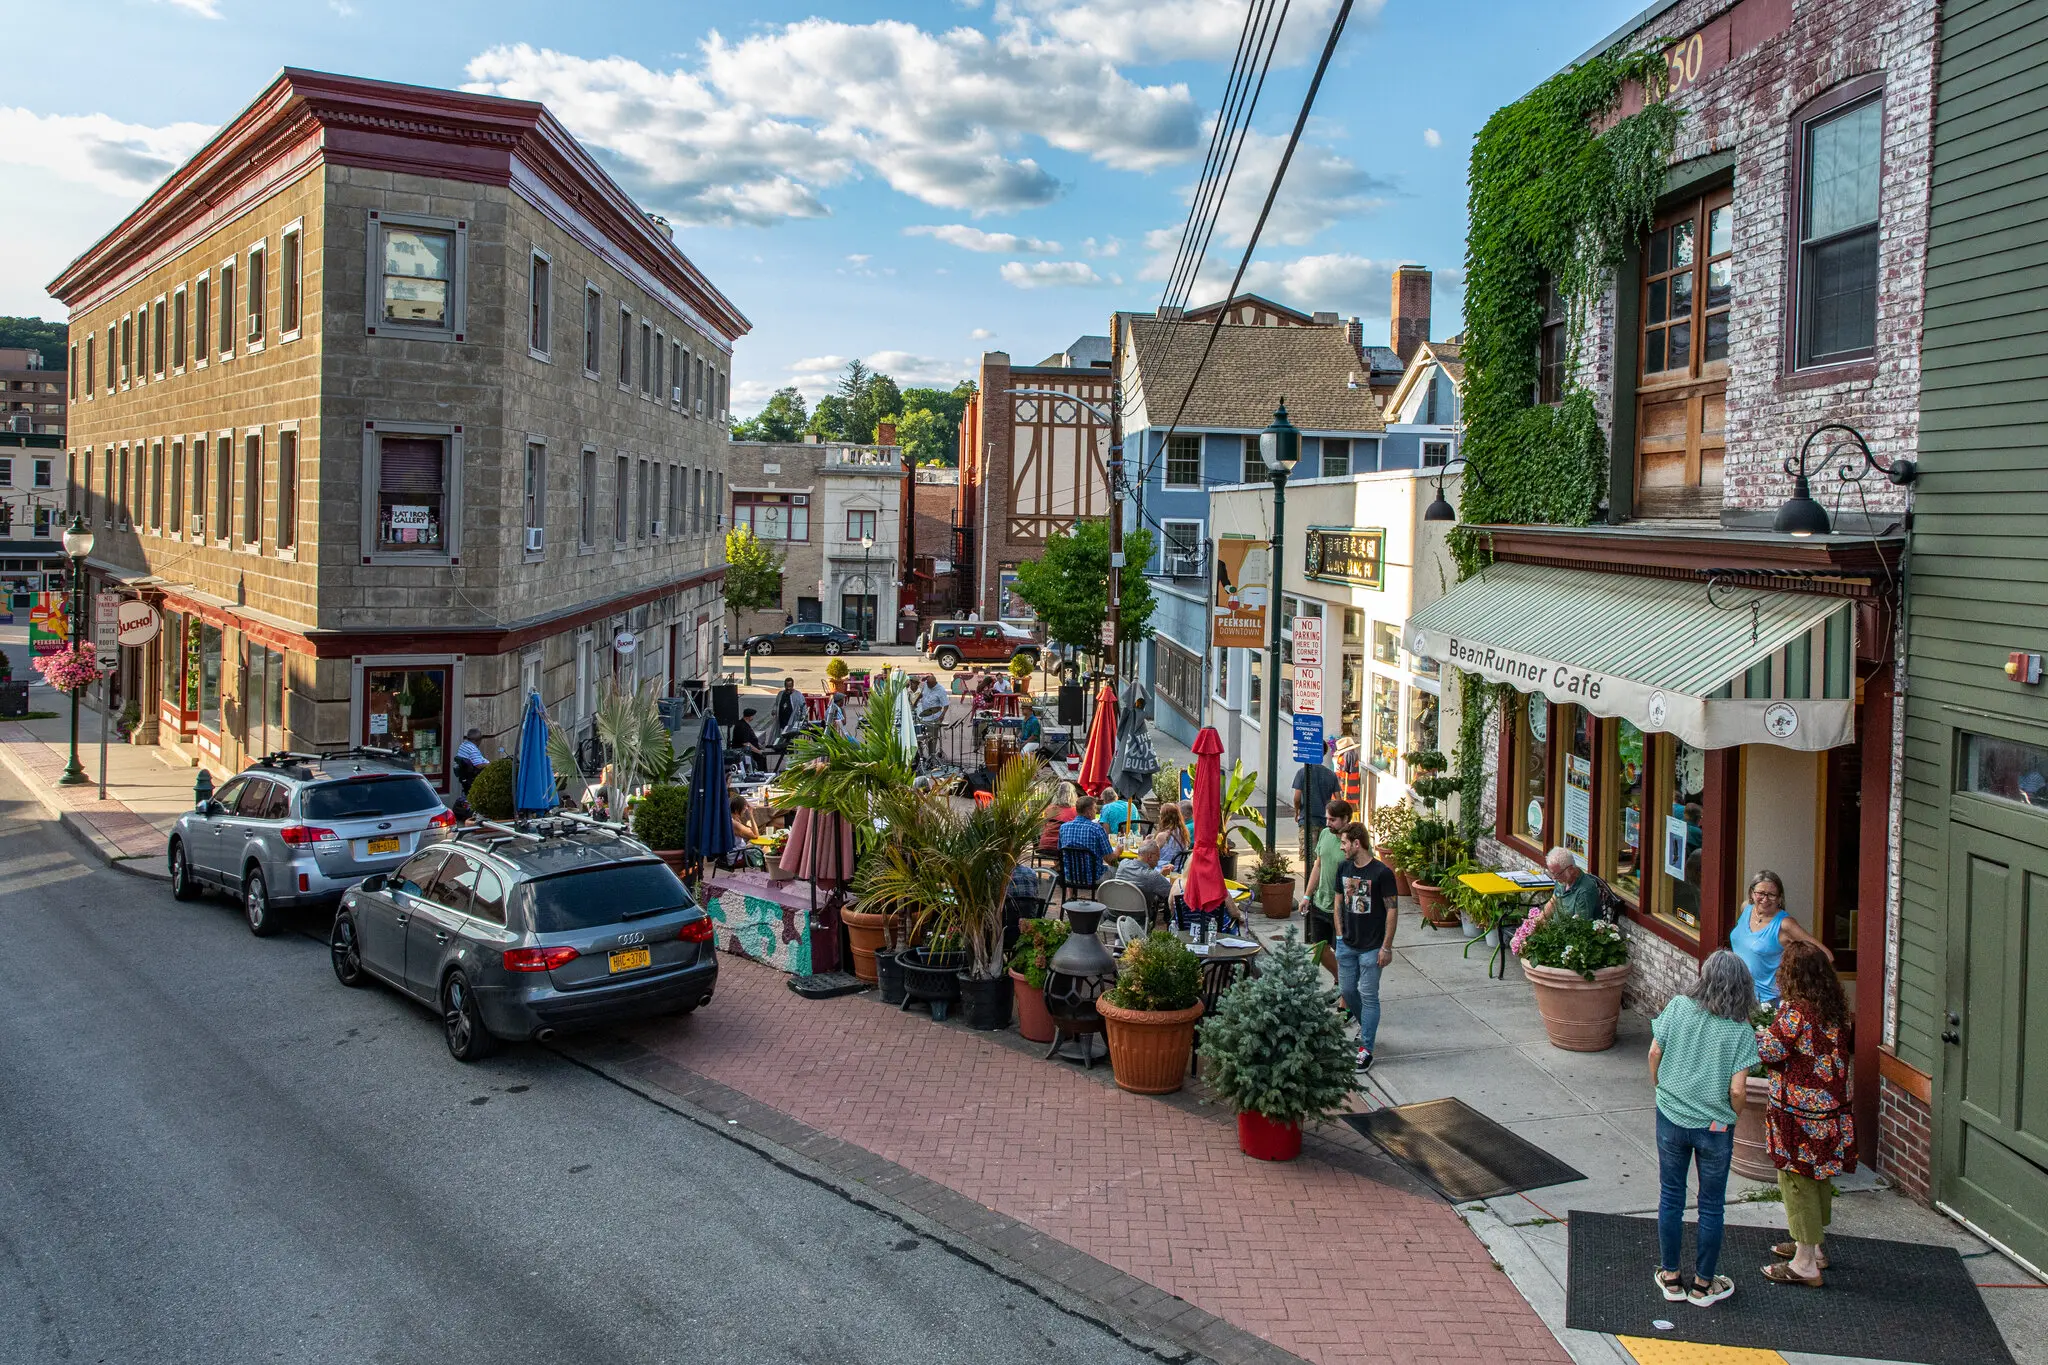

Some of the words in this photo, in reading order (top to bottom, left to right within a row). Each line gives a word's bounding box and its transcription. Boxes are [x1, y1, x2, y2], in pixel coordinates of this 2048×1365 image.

[1218, 618, 1262, 628] PEEKSKILL
[1301, 620, 1313, 630] NO
[1219, 627, 1260, 636] DOWNTOWN
[1295, 631, 1320, 641] PARKING
[1296, 648, 1319, 656] CORNER
[1301, 669, 1314, 679] NO
[1450, 638, 1548, 683] BeanRunner
[1553, 666, 1603, 700] Café
[1295, 680, 1321, 690] PARKING
[1296, 690, 1320, 699] LOADING
[1136, 731, 1152, 743] THE
